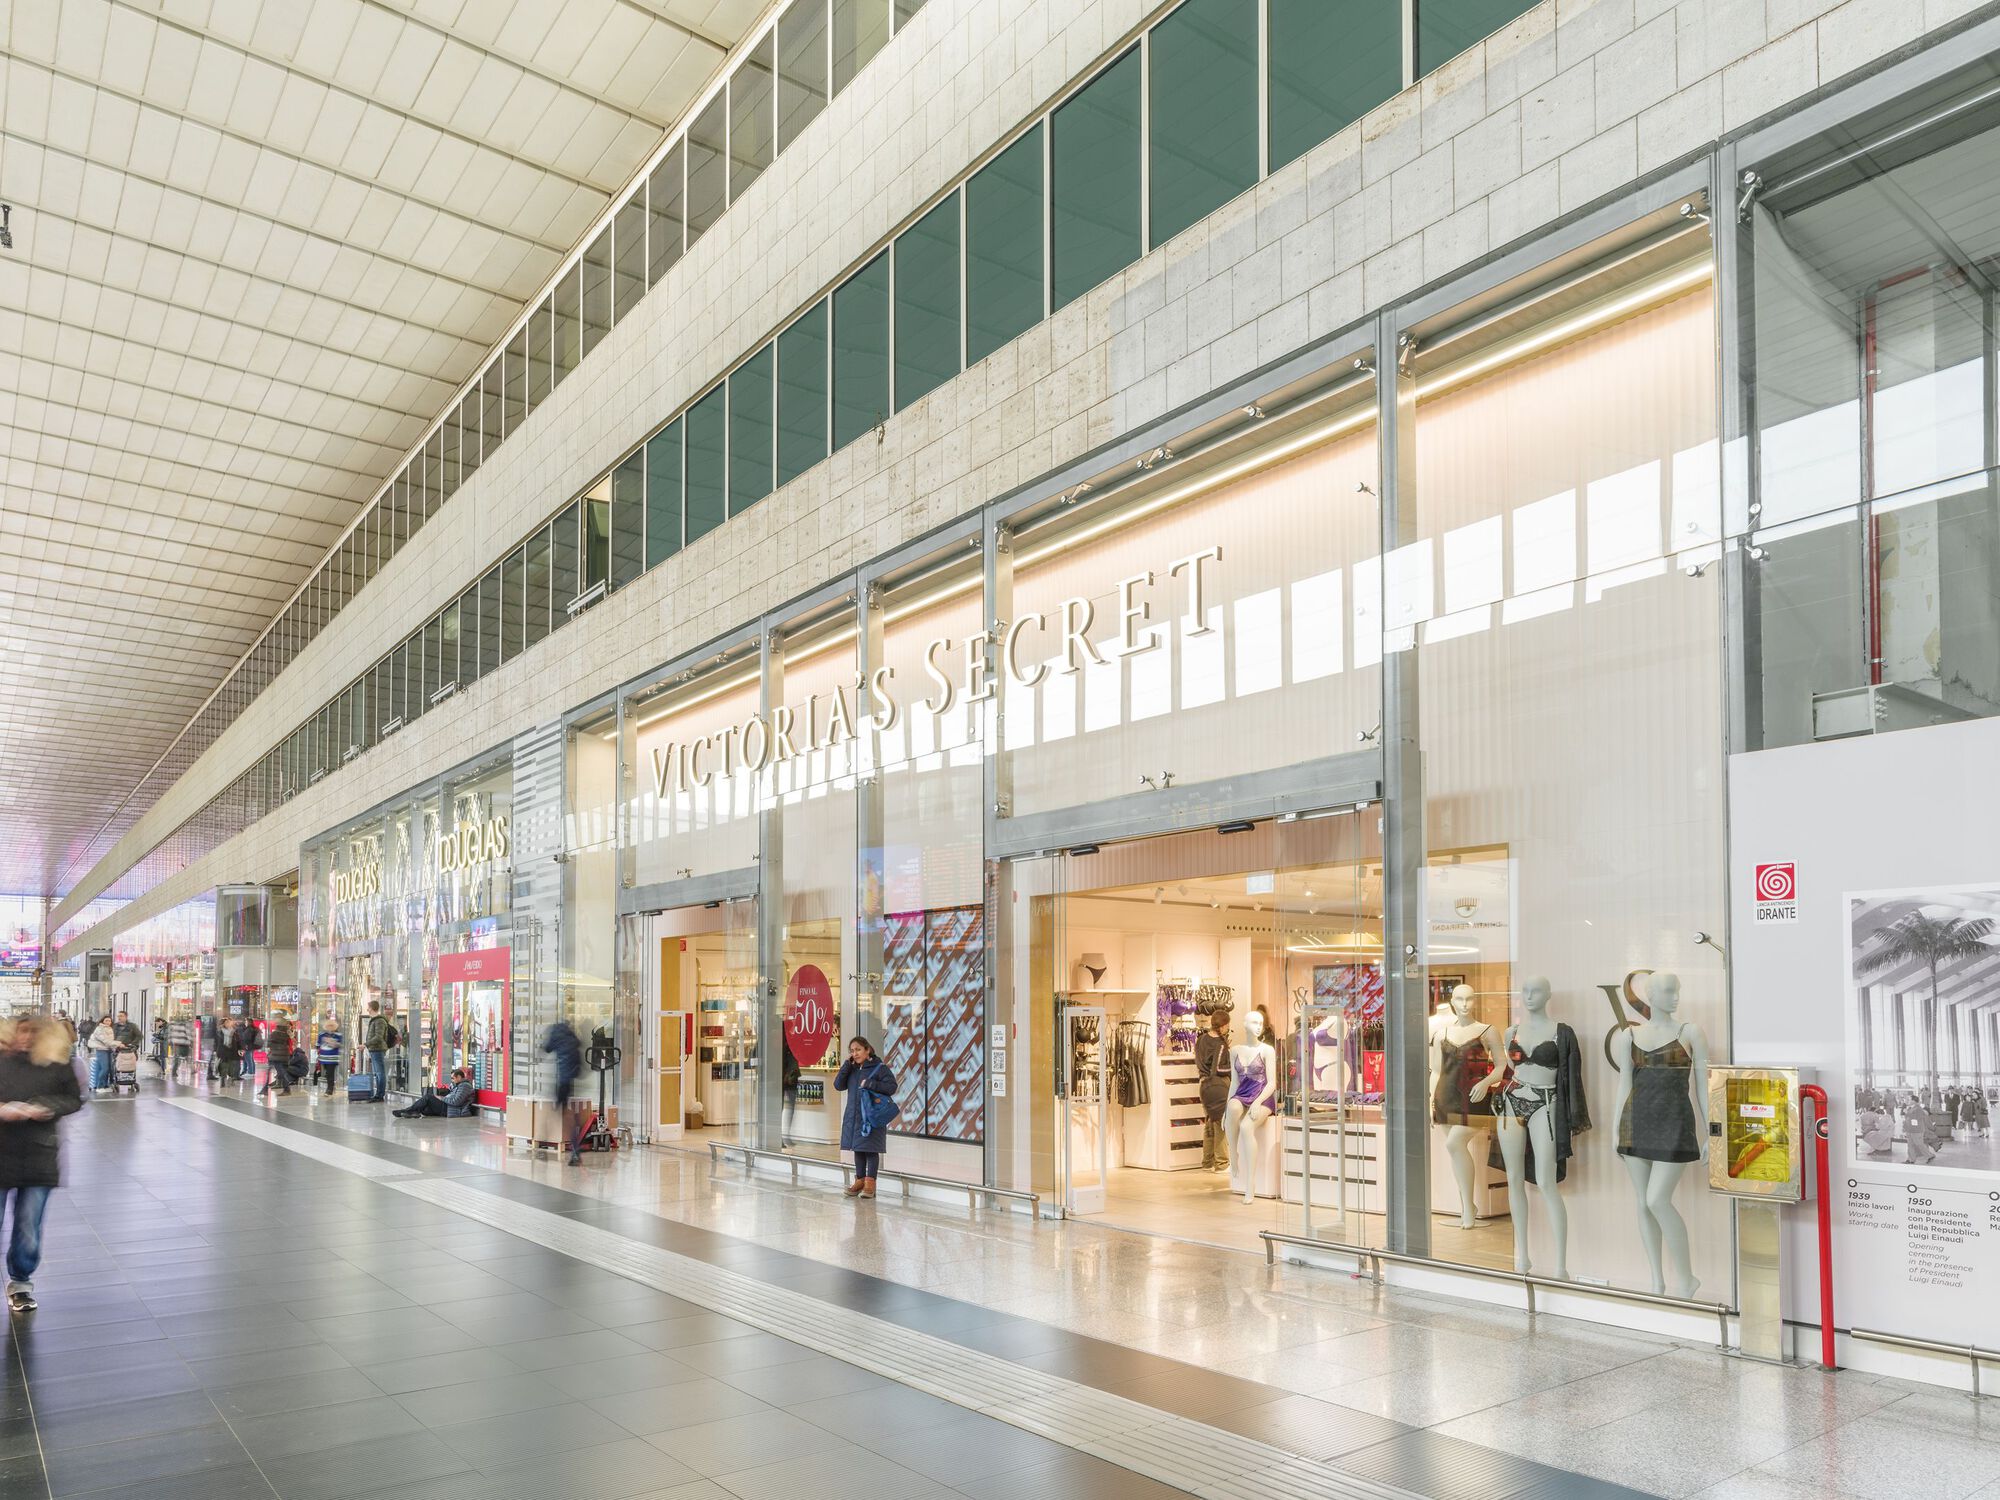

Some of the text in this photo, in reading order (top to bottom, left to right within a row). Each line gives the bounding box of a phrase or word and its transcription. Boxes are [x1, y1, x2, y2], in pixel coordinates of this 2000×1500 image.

[652, 545, 1223, 799] VICTORIA'S SECRET
[440, 815, 508, 875] DOUGLAS
[336, 861, 379, 905] DOUGLAS
[1757, 907, 1796, 920] IDRANTE
[1848, 1192, 1870, 1200] 1939
[1908, 1197, 1932, 1206] 1950
[1848, 1201, 1895, 1211] Inizio lavori
[1848, 1210, 1873, 1219] Works
[1907, 1206, 1969, 1219] Inaugurazione
[1848, 1219, 1899, 1230] starting date
[1925, 1216, 1972, 1228] Presidente
[1907, 1223, 1980, 1237] della Repubblica
[1908, 1231, 1964, 1243] Luigi Einaudi
[1908, 1241, 1945, 1252] Opening
[1908, 1250, 1951, 1261] ceremony
[1918, 1259, 1932, 1267] the
[1934, 1262, 1974, 1273] presence
[1920, 1267, 1960, 1279] President
[1908, 1274, 1963, 1288] Luigi Einaudi
